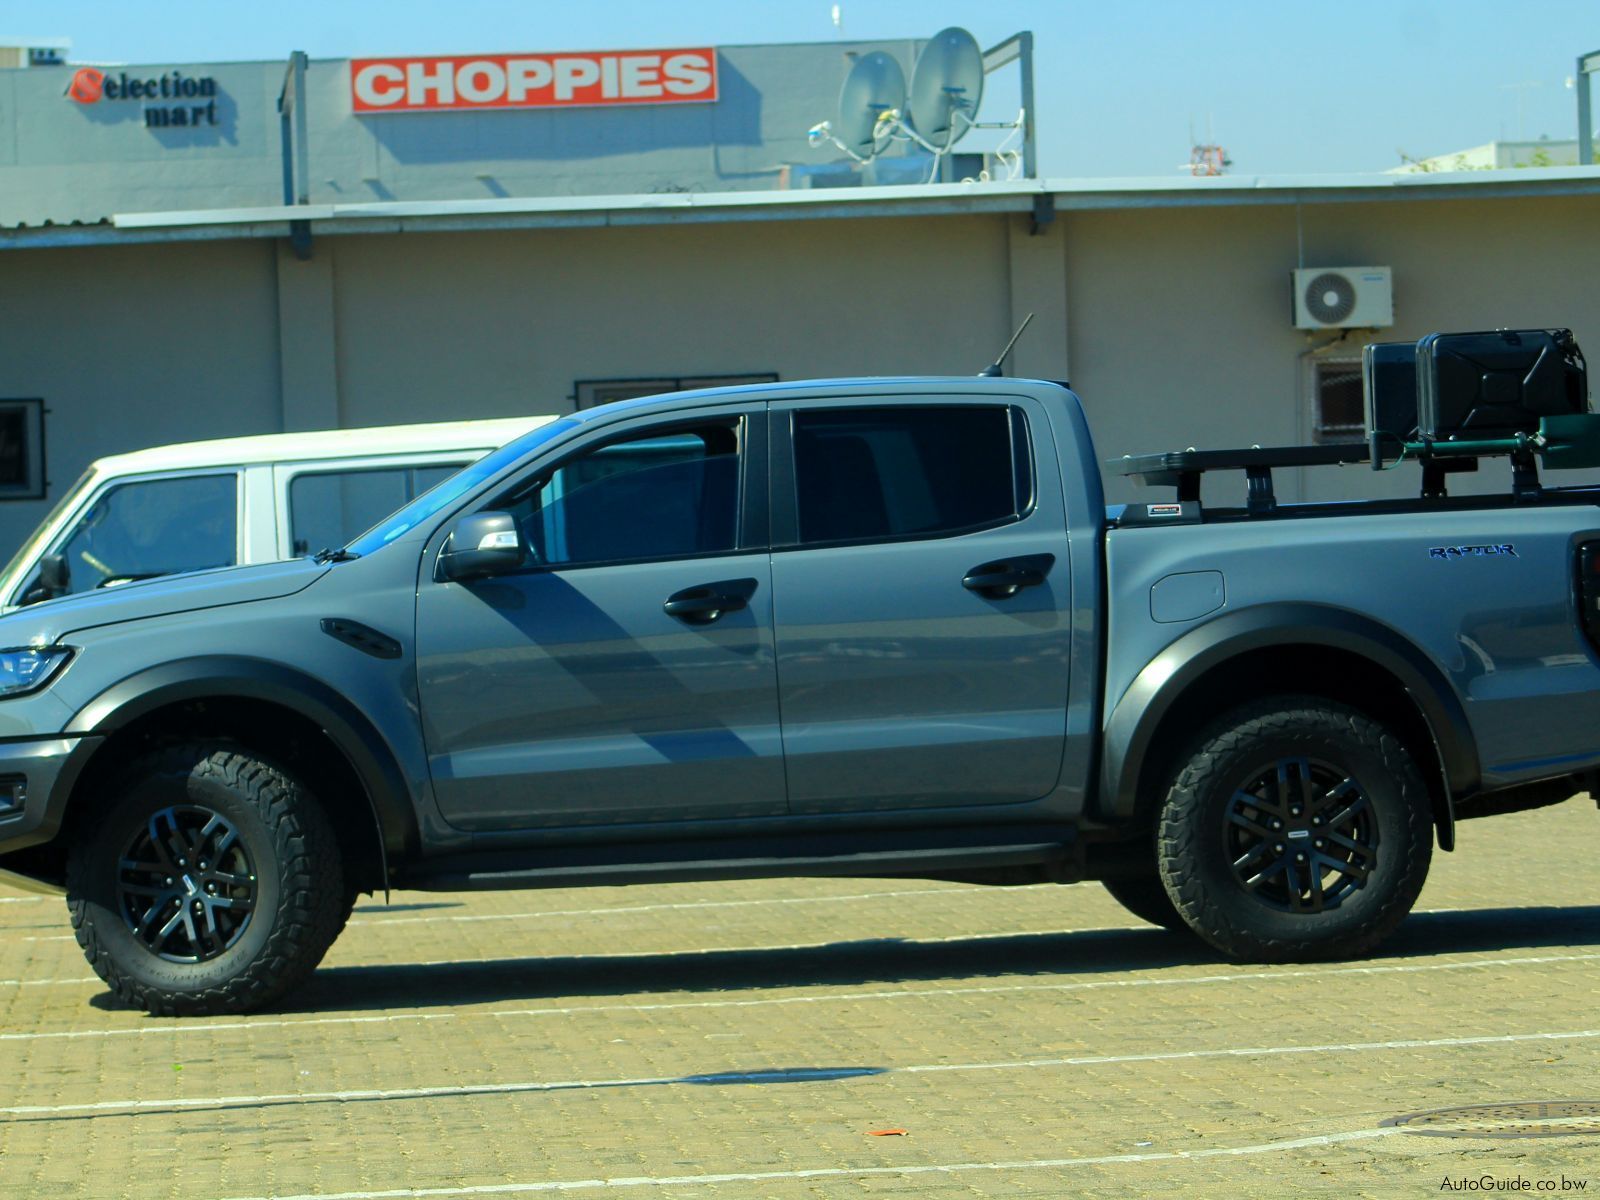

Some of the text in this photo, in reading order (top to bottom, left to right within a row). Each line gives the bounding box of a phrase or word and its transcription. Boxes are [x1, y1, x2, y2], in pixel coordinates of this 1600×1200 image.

[67, 68, 216, 104] Selection
[354, 54, 712, 106] CHOPPIES
[145, 100, 217, 127] mart
[1429, 544, 1519, 560] RAPTOR
